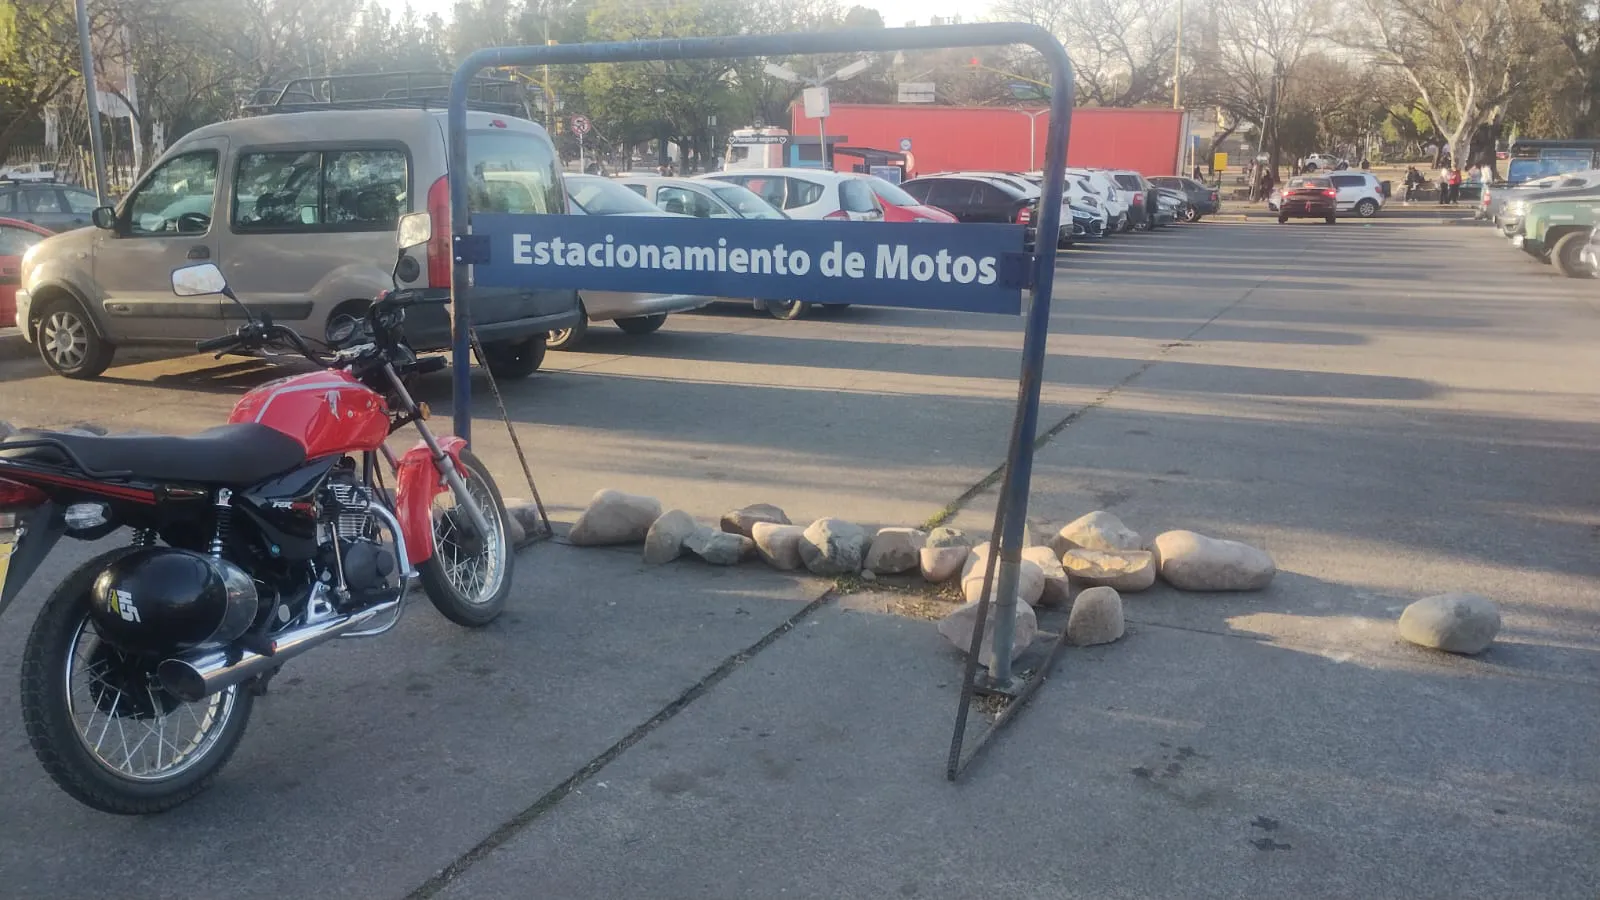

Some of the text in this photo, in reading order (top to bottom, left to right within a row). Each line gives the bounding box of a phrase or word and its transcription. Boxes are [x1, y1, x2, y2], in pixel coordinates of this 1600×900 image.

[512, 233, 997, 285] Estacionamiento de Motos
